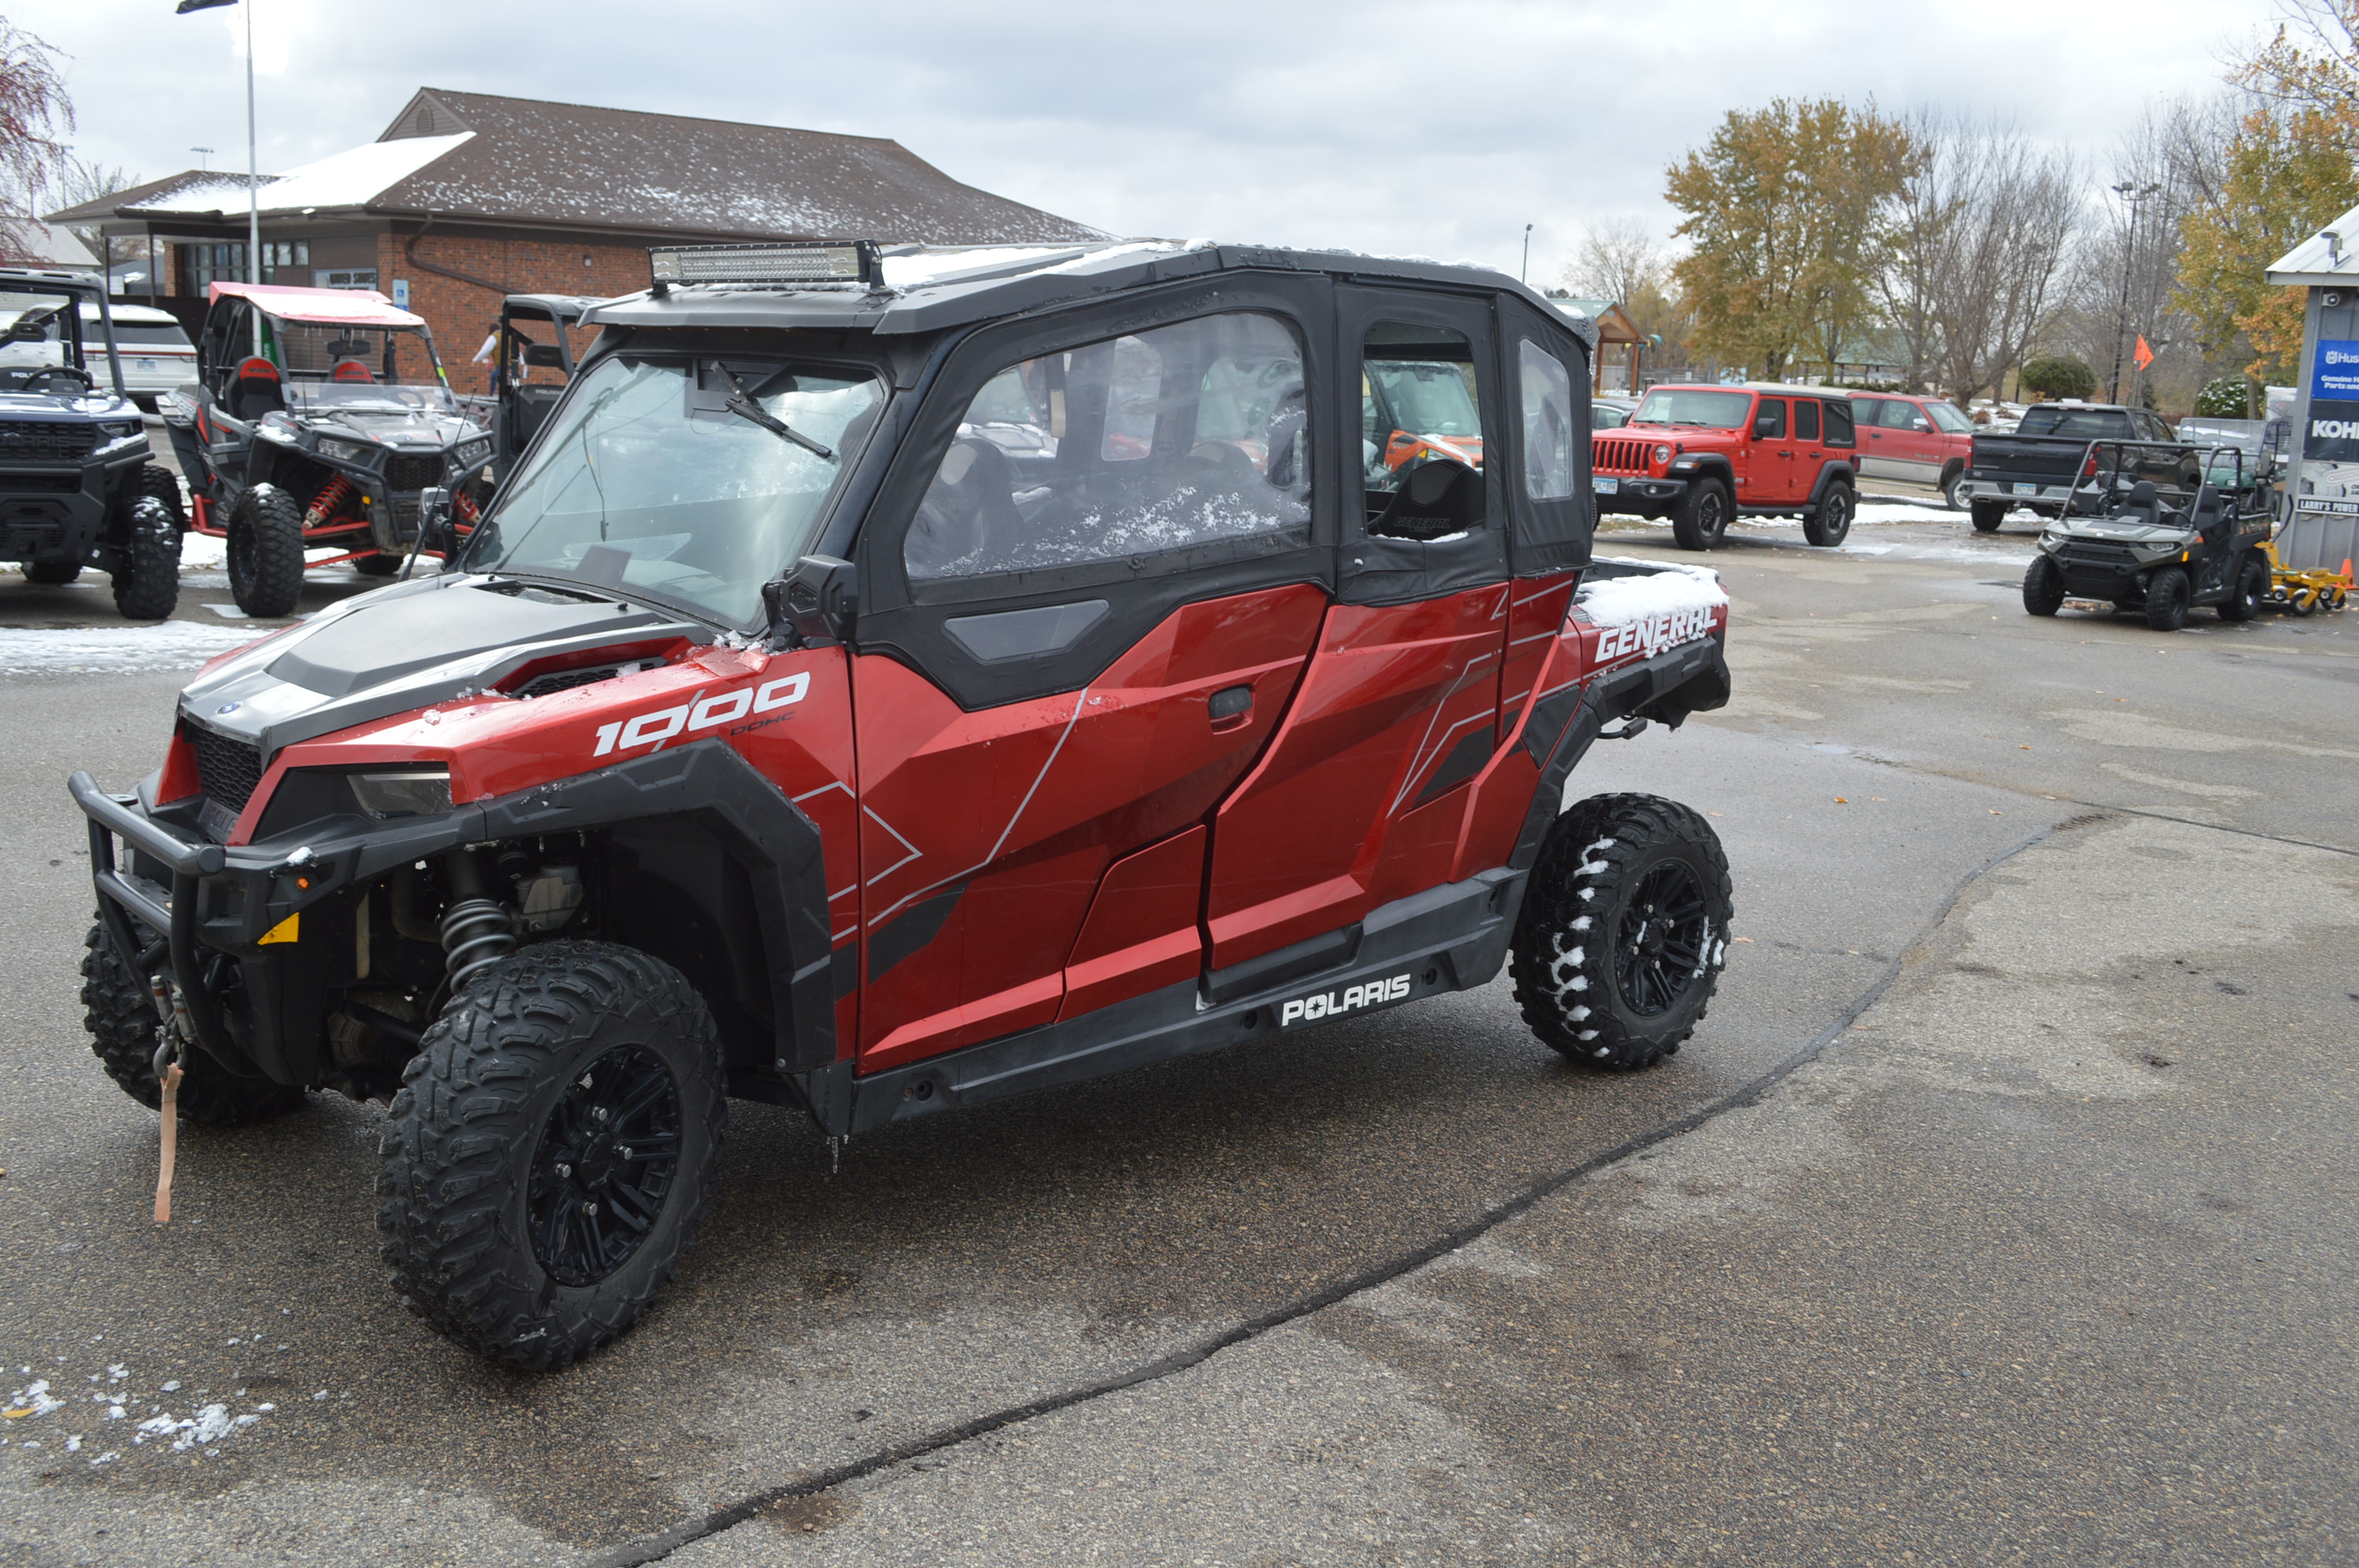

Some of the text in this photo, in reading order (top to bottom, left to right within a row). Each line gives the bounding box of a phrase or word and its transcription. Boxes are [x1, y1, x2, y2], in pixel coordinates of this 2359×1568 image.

[2300, 500, 2358, 514] LARRY'S POWER
[1594, 607, 1717, 663] GENERAL
[593, 671, 811, 757] 1000
[729, 711, 795, 736] DOHC
[1281, 974, 1411, 1026] POLARIS
